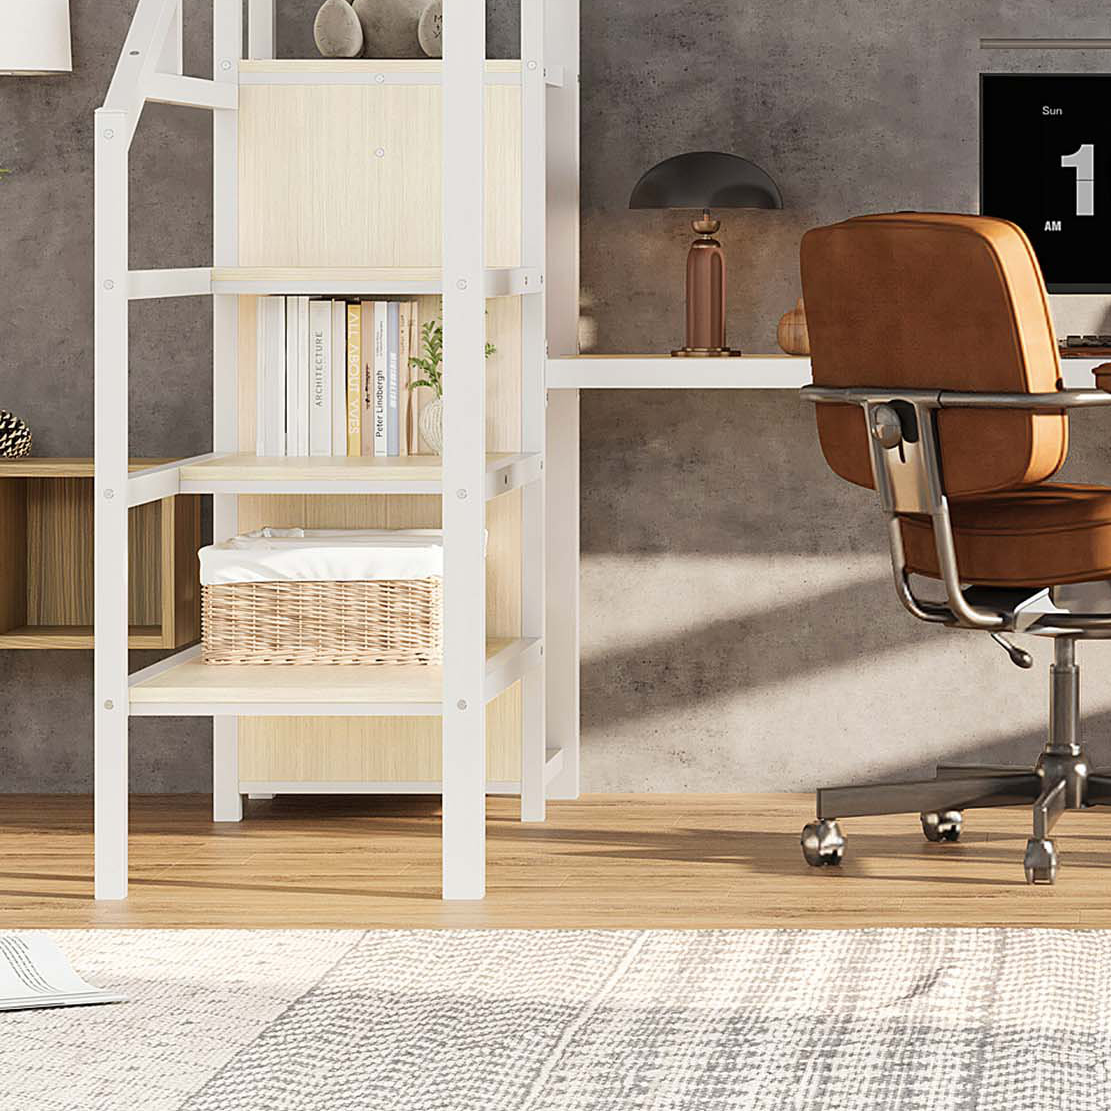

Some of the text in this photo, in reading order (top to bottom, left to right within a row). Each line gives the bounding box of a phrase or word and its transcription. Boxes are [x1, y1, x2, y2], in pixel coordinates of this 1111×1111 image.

[1042, 105, 1063, 116] Sun
[1044, 220, 1062, 232] AM
[315, 330, 324, 408] ARCHITECTURE
[349, 312, 360, 434] ALL ABOUT YVES
[375, 370, 386, 438] Peter Lindbergh
